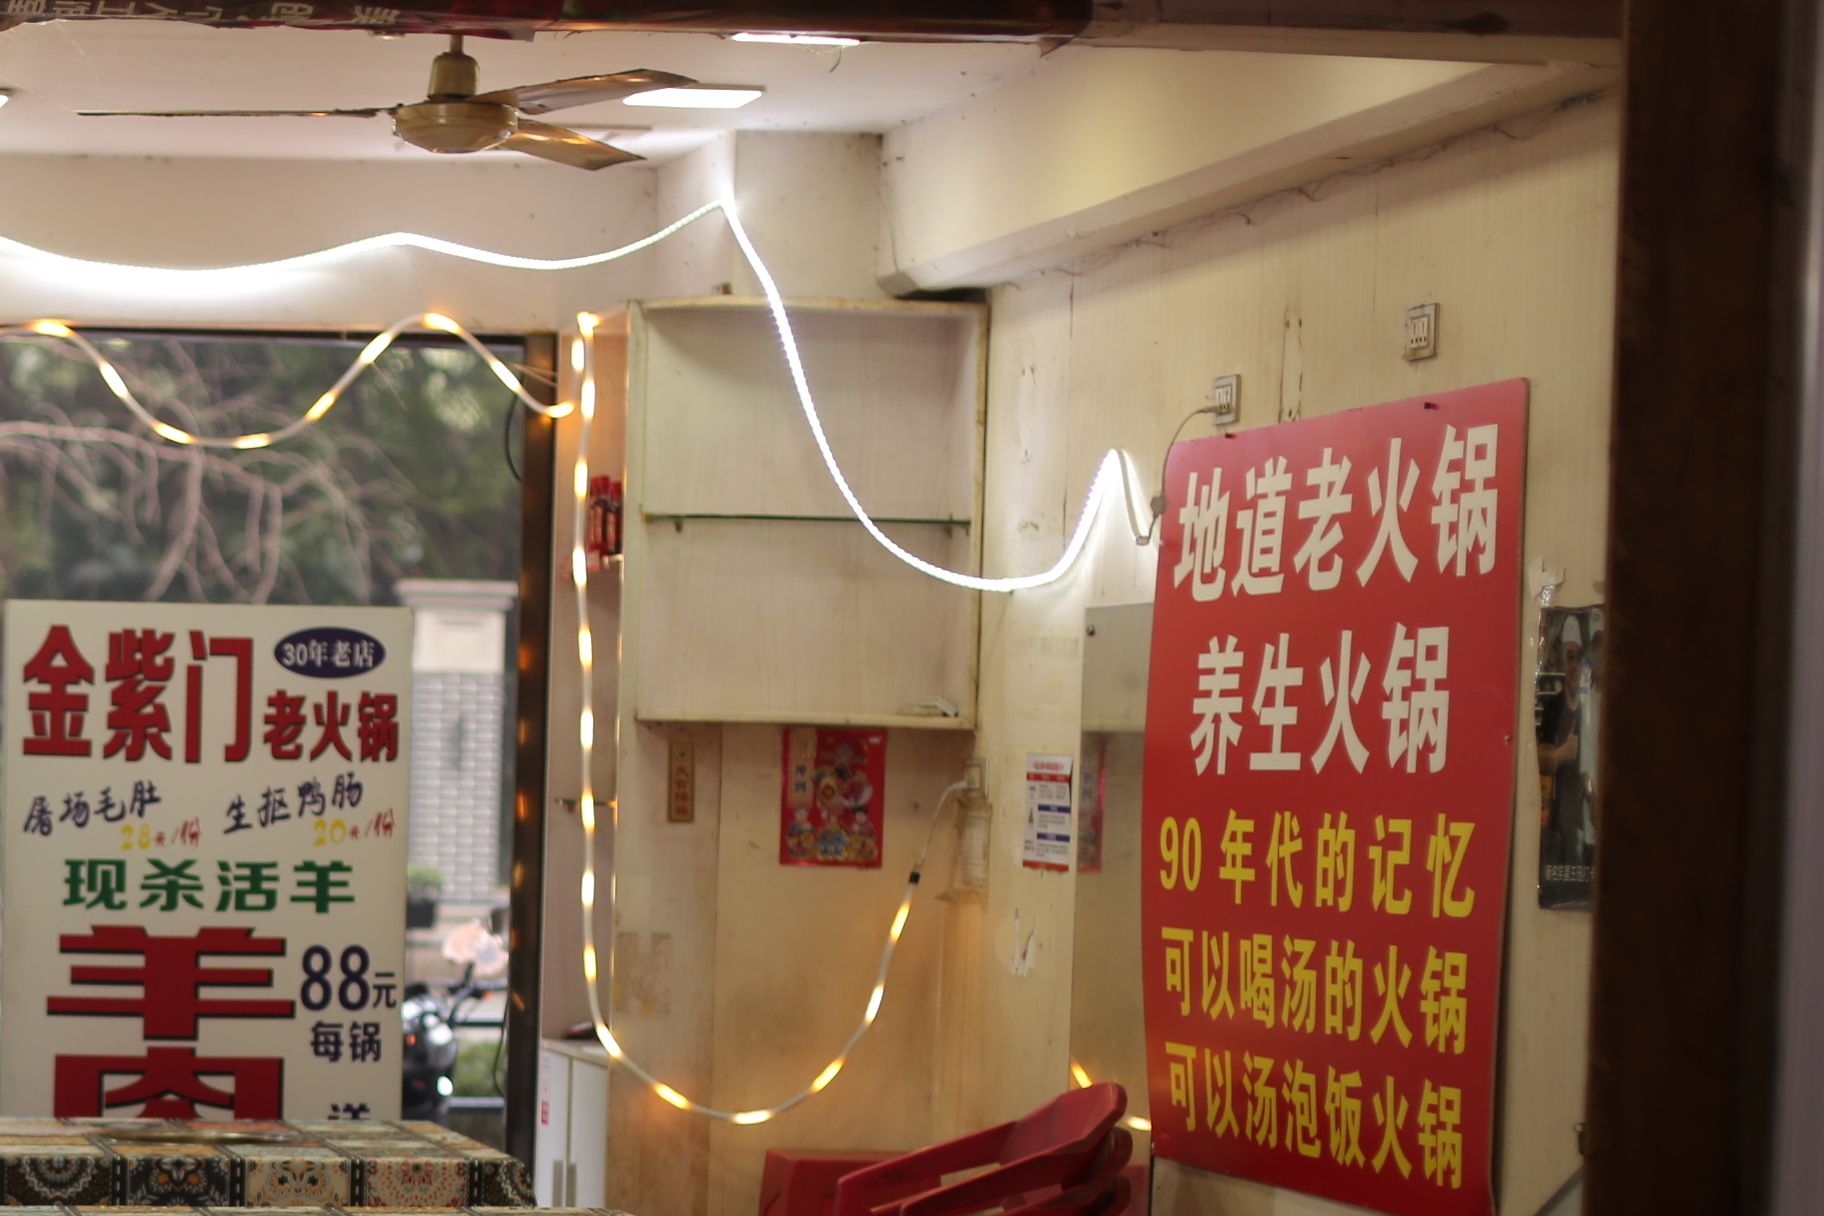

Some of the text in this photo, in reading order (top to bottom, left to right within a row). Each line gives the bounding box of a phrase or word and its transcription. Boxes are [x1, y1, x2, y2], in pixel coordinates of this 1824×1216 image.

[1174, 423, 1499, 602] 地道老火锅
[23, 625, 253, 763] 金紫门
[282, 639, 376, 670] 30年老店
[1190, 622, 1451, 776] 养生火锅
[263, 690, 400, 763] 老火锅
[23, 779, 162, 837] 屠场毛肚
[62, 858, 356, 913] 现杀活羊
[310, 1020, 382, 1062] 每锅
[1161, 926, 1469, 1055] 可以喝汤的火锅
[1165, 1041, 1464, 1190] 可以汤泡饭火锅
